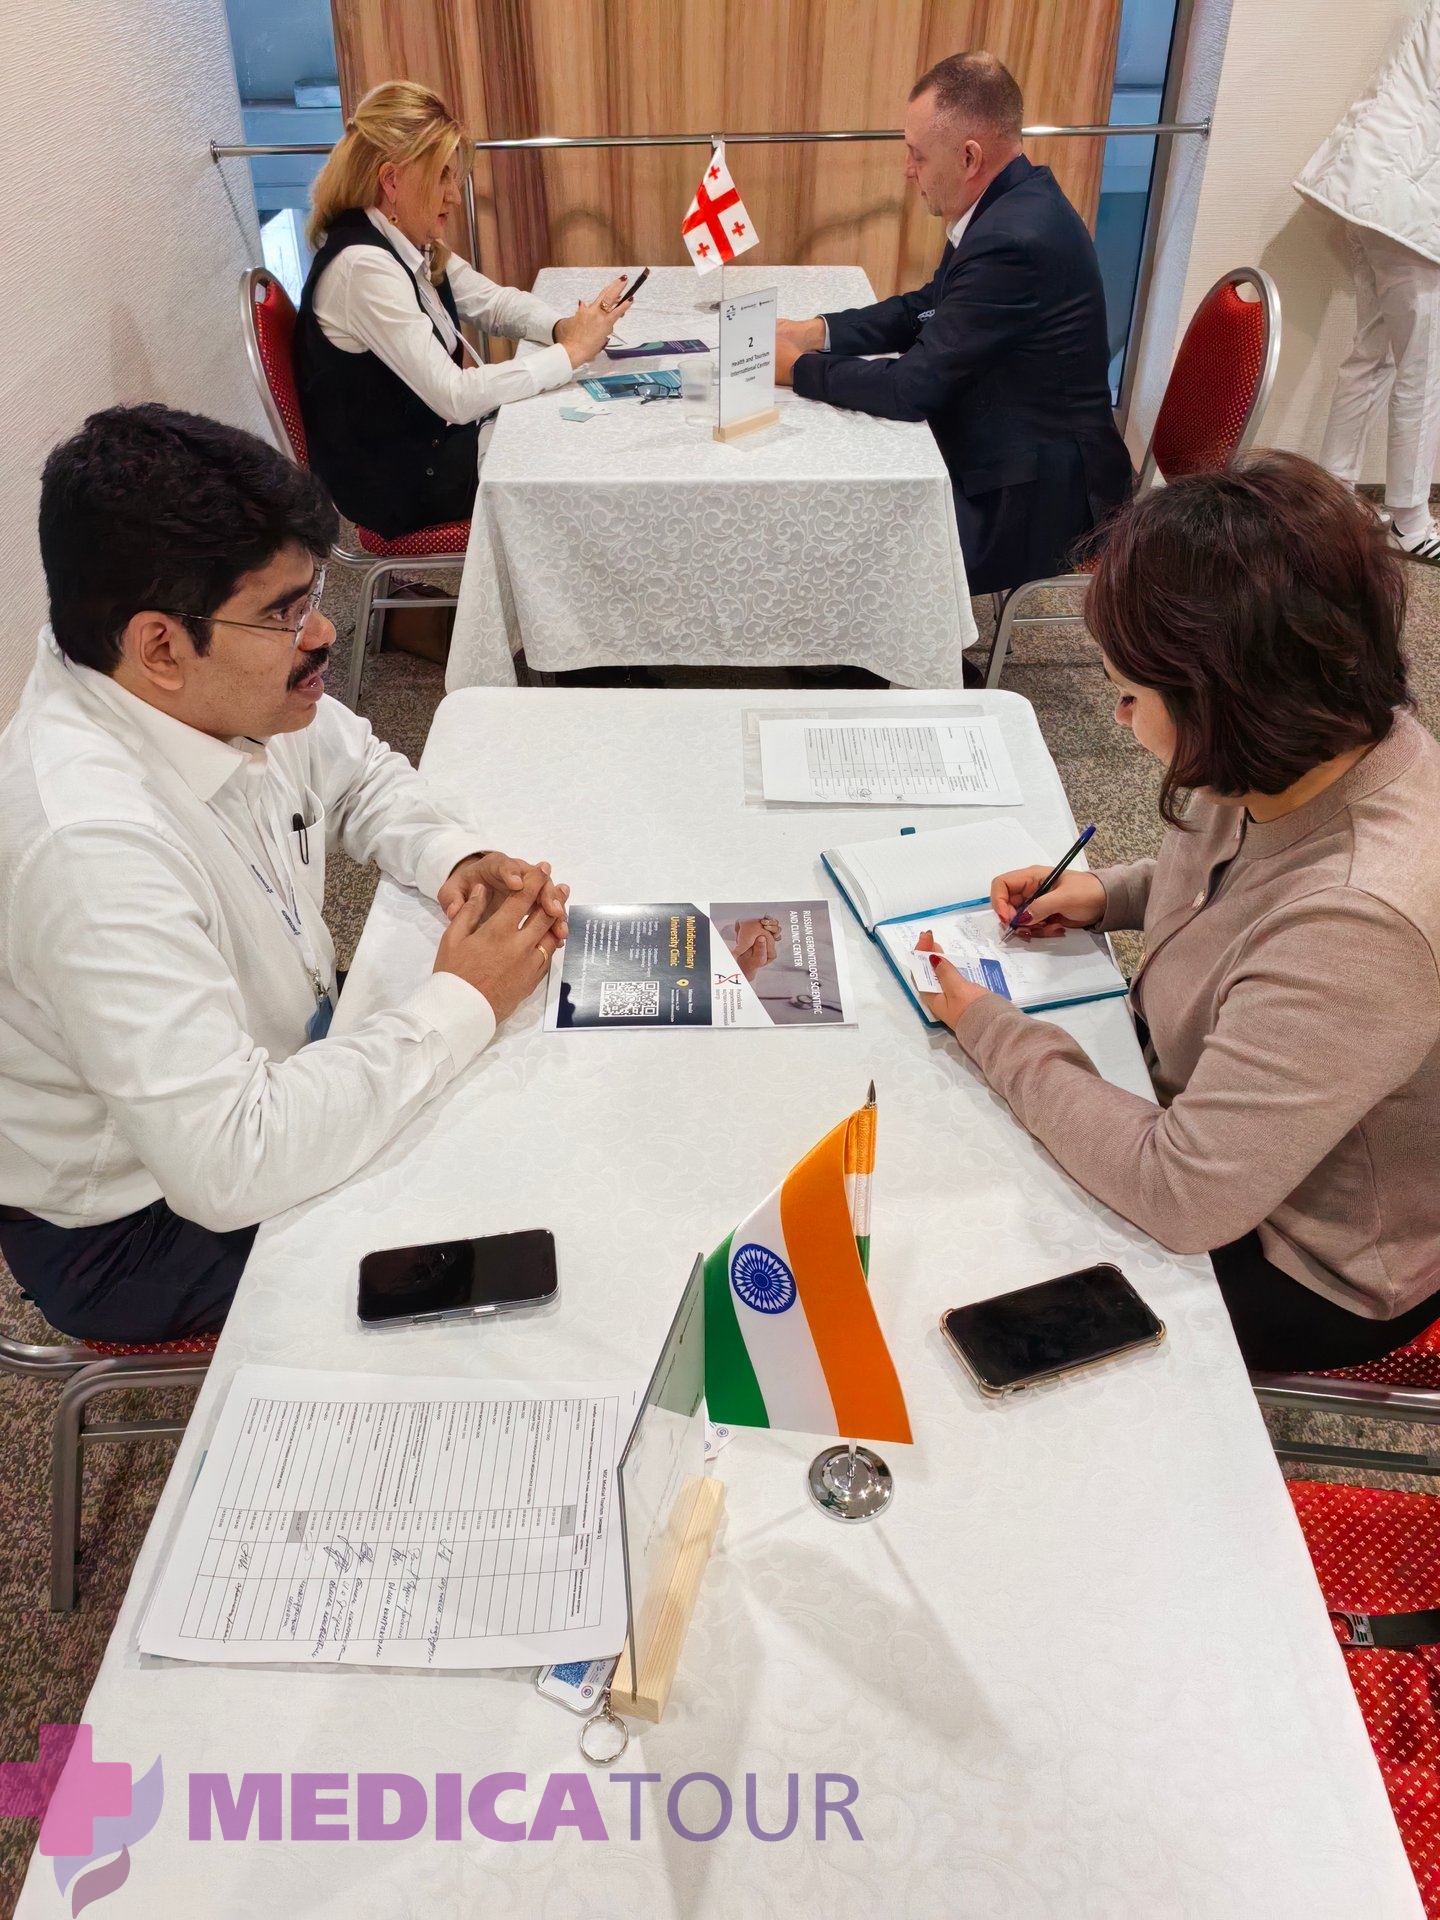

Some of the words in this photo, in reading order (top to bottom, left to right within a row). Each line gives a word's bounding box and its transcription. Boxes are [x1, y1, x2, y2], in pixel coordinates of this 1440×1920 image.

[748, 336, 754, 348] 2
[730, 363, 756, 377] International
[757, 361, 770, 369] Center
[731, 359, 745, 367] Health
[754, 351, 770, 360] Tourism
[789, 910, 799, 924] AND
[803, 910, 813, 935] RUSSIAN
[668, 916, 680, 948] University
[685, 916, 695, 968] Multidisciplinary
[791, 925, 800, 943] CLINIC
[670, 949, 680, 966] Clinic
[792, 944, 802, 967] CENTER
[805, 936, 818, 981] GERONTOLOGY
[810, 982, 823, 1015] SCIENTIFIC
